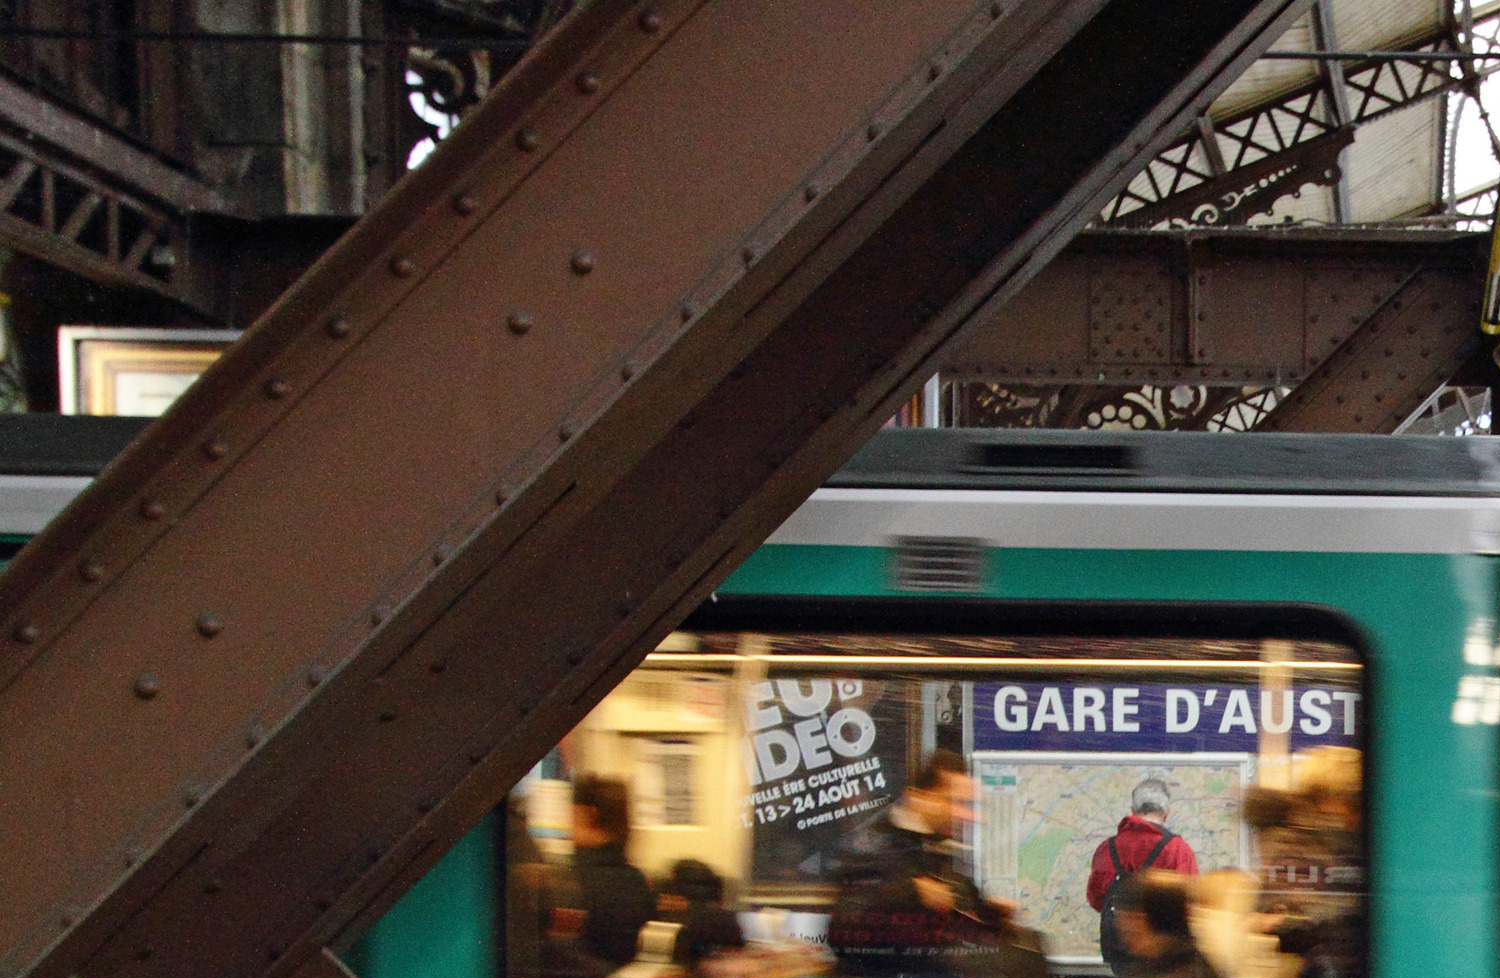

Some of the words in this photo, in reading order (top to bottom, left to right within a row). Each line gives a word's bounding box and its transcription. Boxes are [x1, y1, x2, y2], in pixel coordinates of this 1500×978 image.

[993, 686, 1141, 733] GARE
[1165, 688, 1361, 736] D'AUST
[807, 756, 881, 789] CULTURELLE
[755, 803, 778, 825] 13
[792, 794, 815, 815] 24
[818, 777, 861, 807] AOÛT
[863, 772, 886, 792] 14
[806, 812, 833, 828] PORTE
[834, 808, 847, 819] DE
[847, 803, 859, 814] LA
